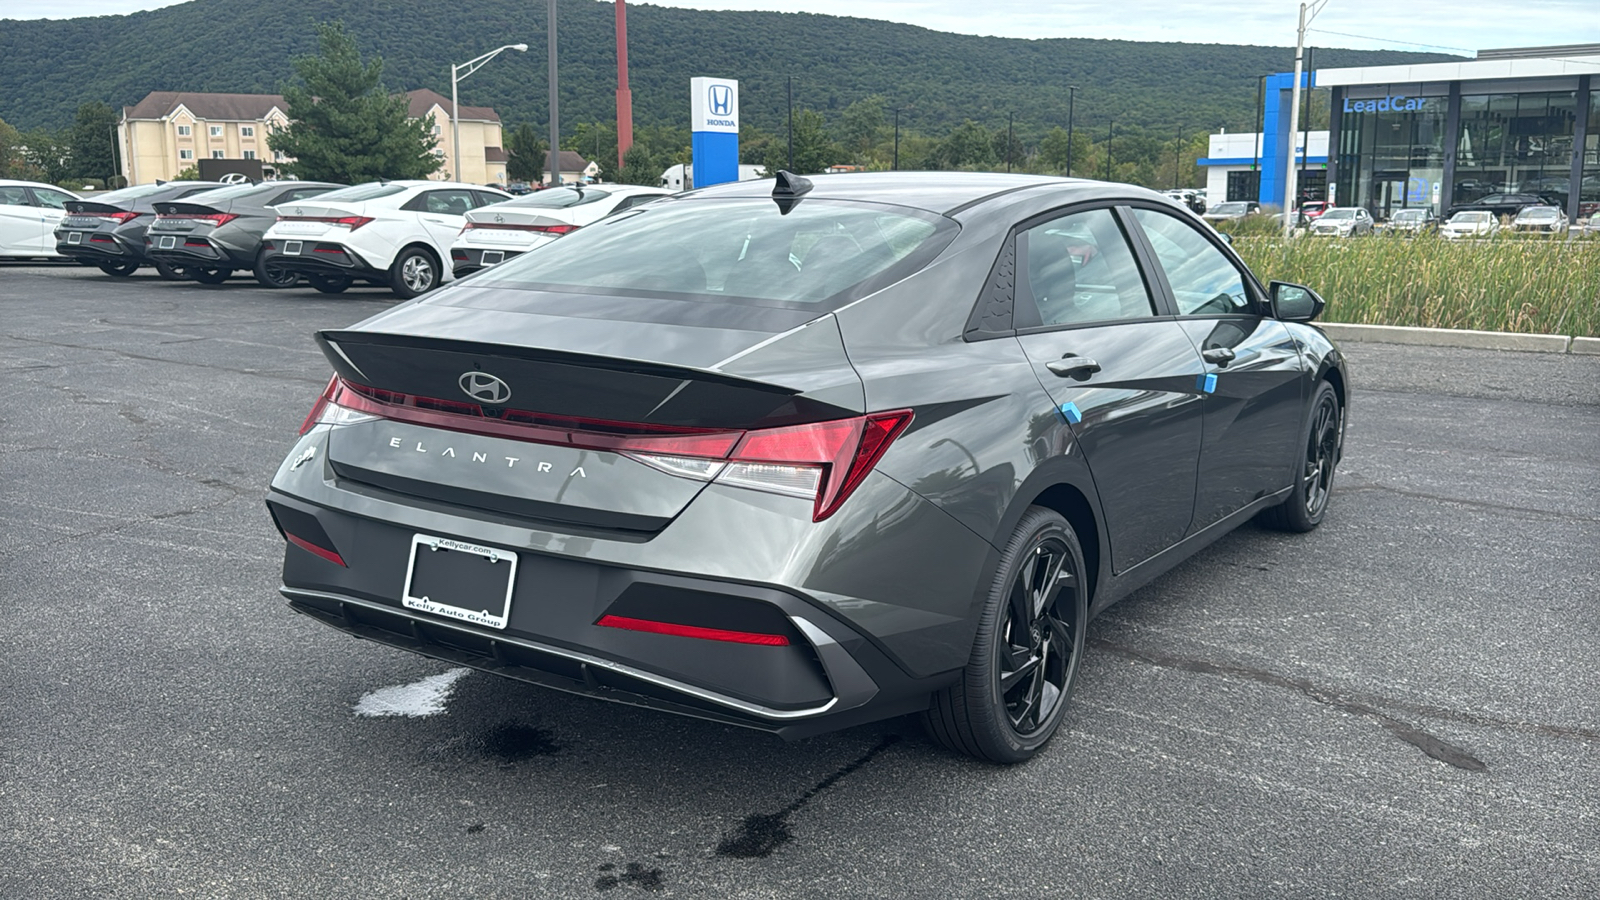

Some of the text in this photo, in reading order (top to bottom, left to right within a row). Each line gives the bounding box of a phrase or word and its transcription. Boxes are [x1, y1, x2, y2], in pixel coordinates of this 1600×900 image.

[1343, 95, 1426, 113] LeadCar
[706, 119, 736, 127] HONDA
[389, 436, 587, 478] ELANTRA
[438, 538, 491, 554] Kellycar.com
[408, 600, 501, 627] Kelly Auto Group
